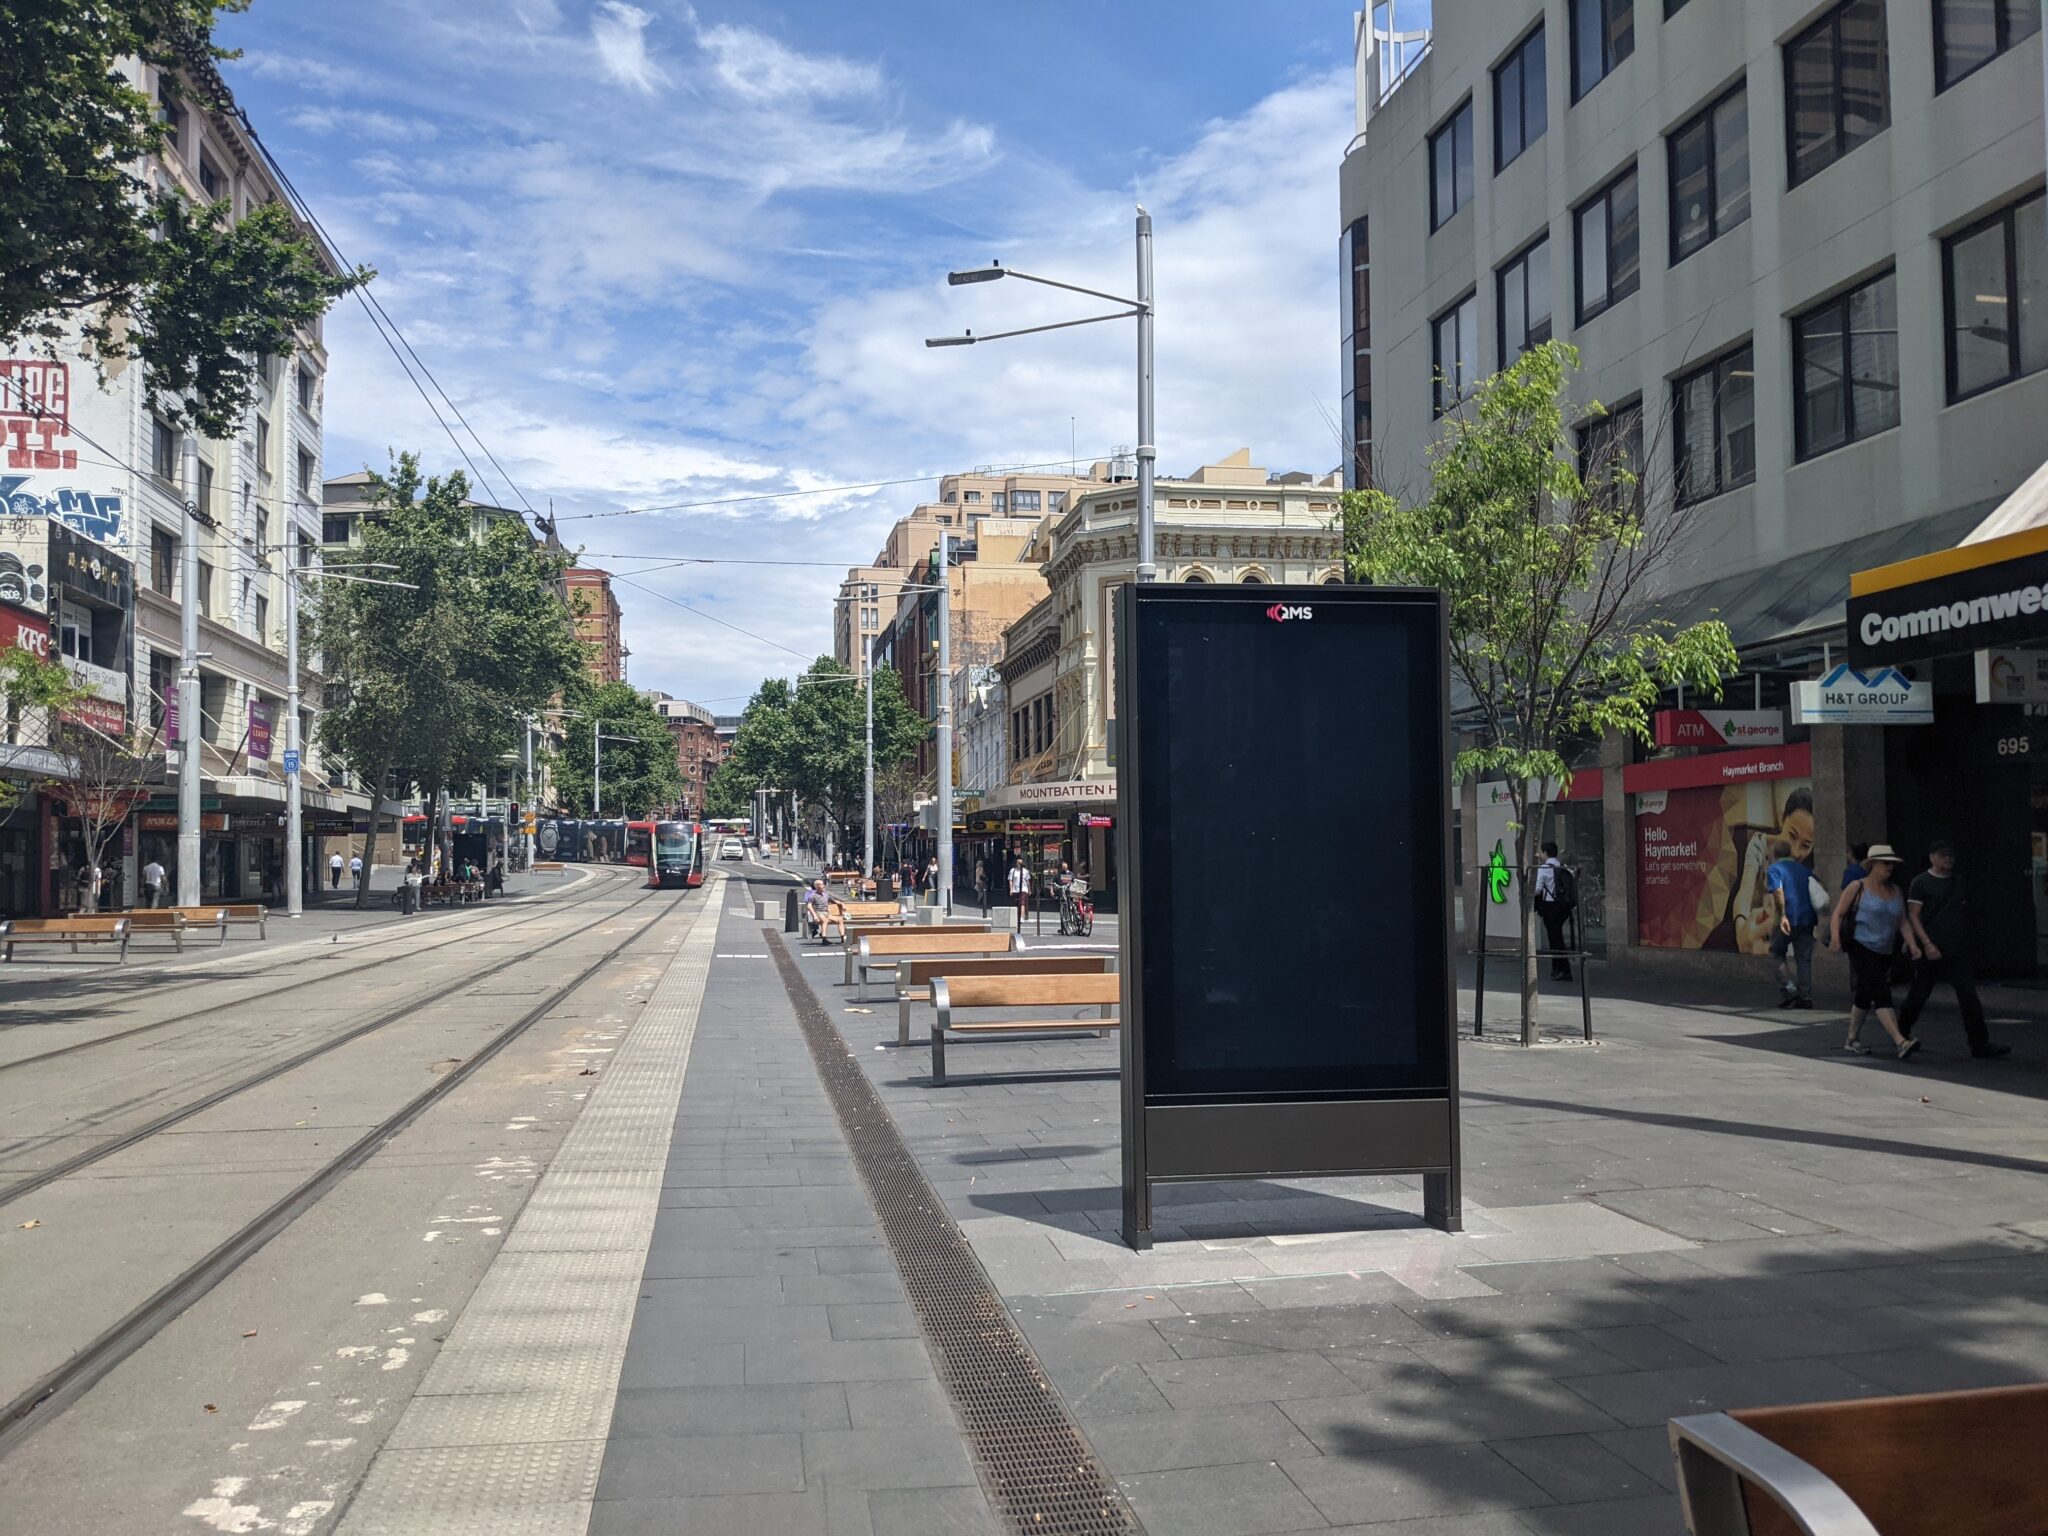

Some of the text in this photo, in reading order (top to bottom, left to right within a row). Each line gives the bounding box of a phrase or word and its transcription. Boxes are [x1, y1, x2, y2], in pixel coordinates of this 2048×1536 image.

[1274, 604, 1313, 621] QMS
[17, 624, 48, 656] KFC
[1825, 693, 1909, 705] H&T GROUP
[252, 730, 268, 739] LEASED
[1677, 723, 1779, 737] ATM st.george
[1997, 737, 2029, 755] 695
[1722, 761, 1784, 778] Haymarket Branch
[1019, 784, 1105, 799] MOUNTBATTEN
[1644, 826, 1668, 842] Hello
[1645, 841, 1697, 860] Haymarket!
[1645, 861, 1706, 873] Let's get something
